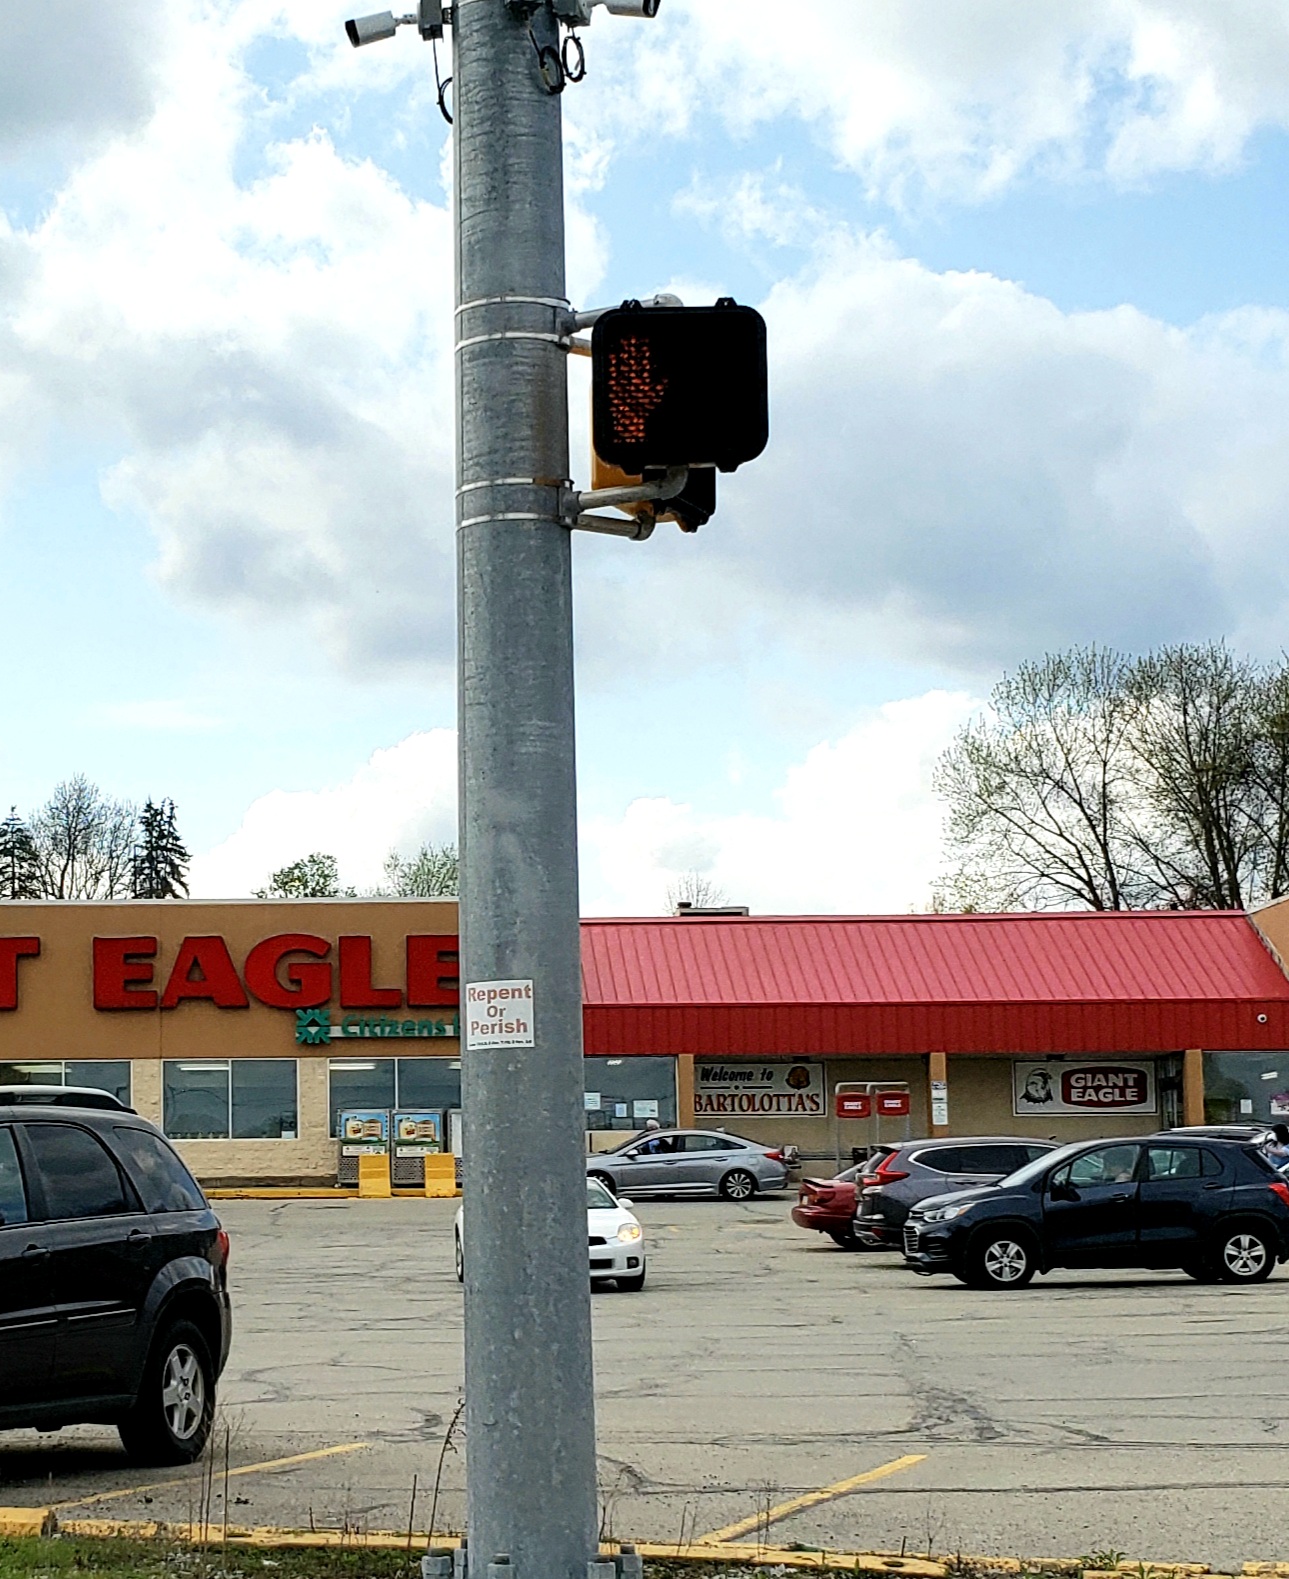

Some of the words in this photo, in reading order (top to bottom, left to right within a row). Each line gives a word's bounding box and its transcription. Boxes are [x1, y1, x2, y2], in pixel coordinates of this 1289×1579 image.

[92, 933, 460, 1010] EAGLE
[467, 984, 533, 1004] Repent
[486, 1005, 507, 1018] Or
[341, 1013, 446, 1037] Citizens
[470, 1018, 528, 1036] Perish
[700, 1066, 754, 1082] Welcome
[760, 1067, 774, 1081] to
[1069, 1073, 1139, 1088] GIANT
[694, 1092, 820, 1113] BARTOLOTTA'S
[1070, 1088, 1139, 1102] EAGLE
